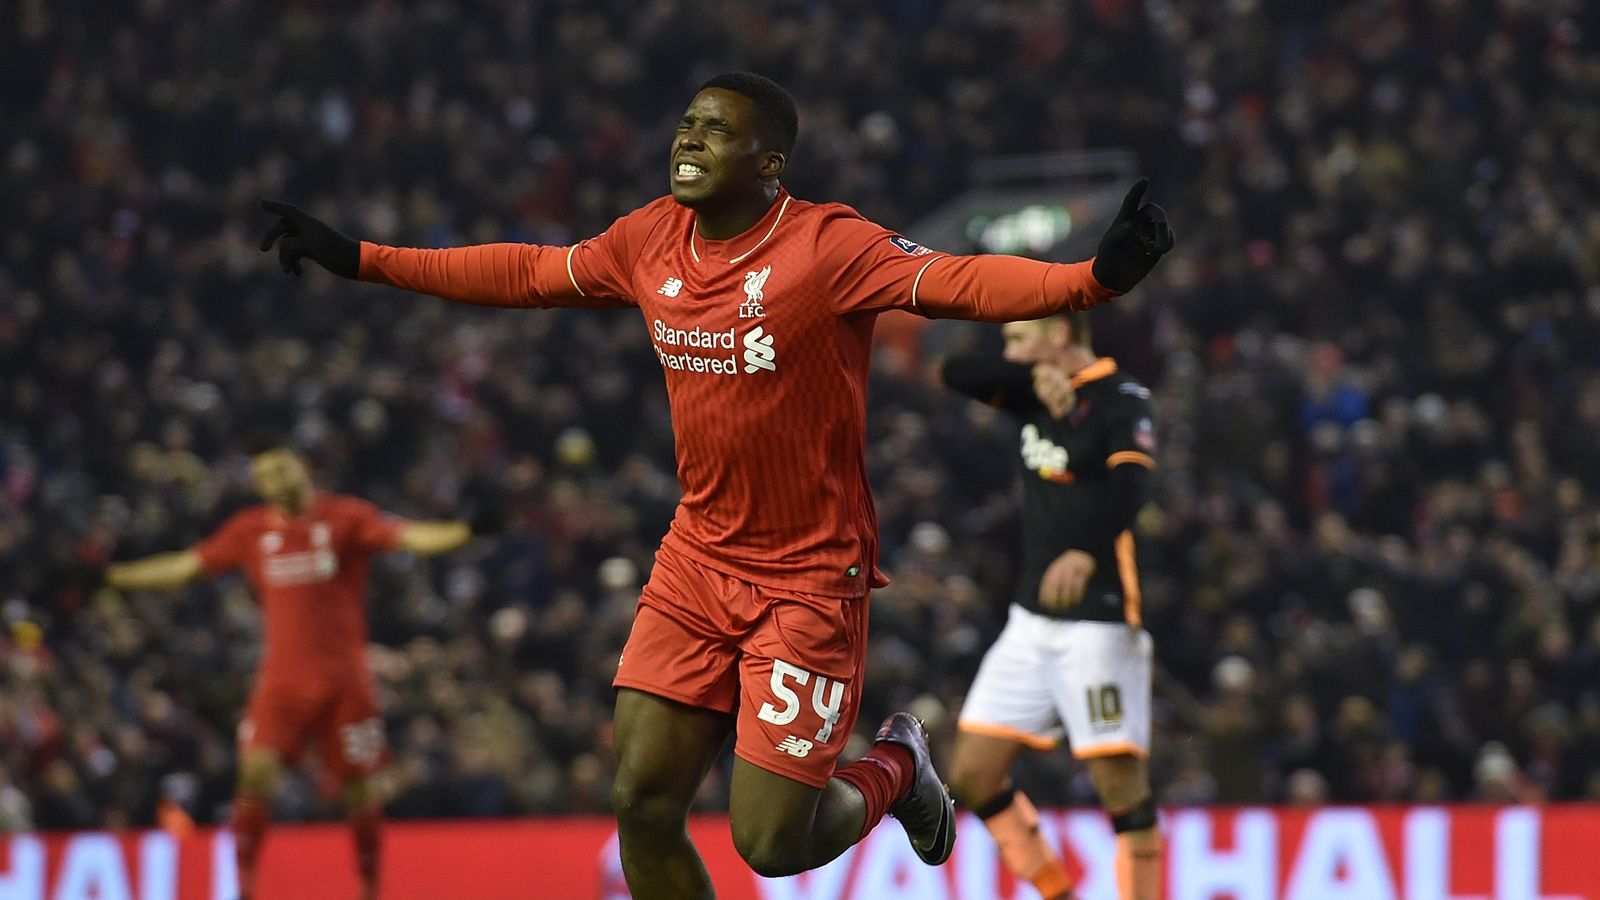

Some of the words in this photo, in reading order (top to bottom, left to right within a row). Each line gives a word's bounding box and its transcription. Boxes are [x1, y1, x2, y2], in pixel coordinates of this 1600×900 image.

[653, 319, 735, 349] Standard
[757, 658, 845, 744] 54
[1086, 683, 1122, 723] 10
